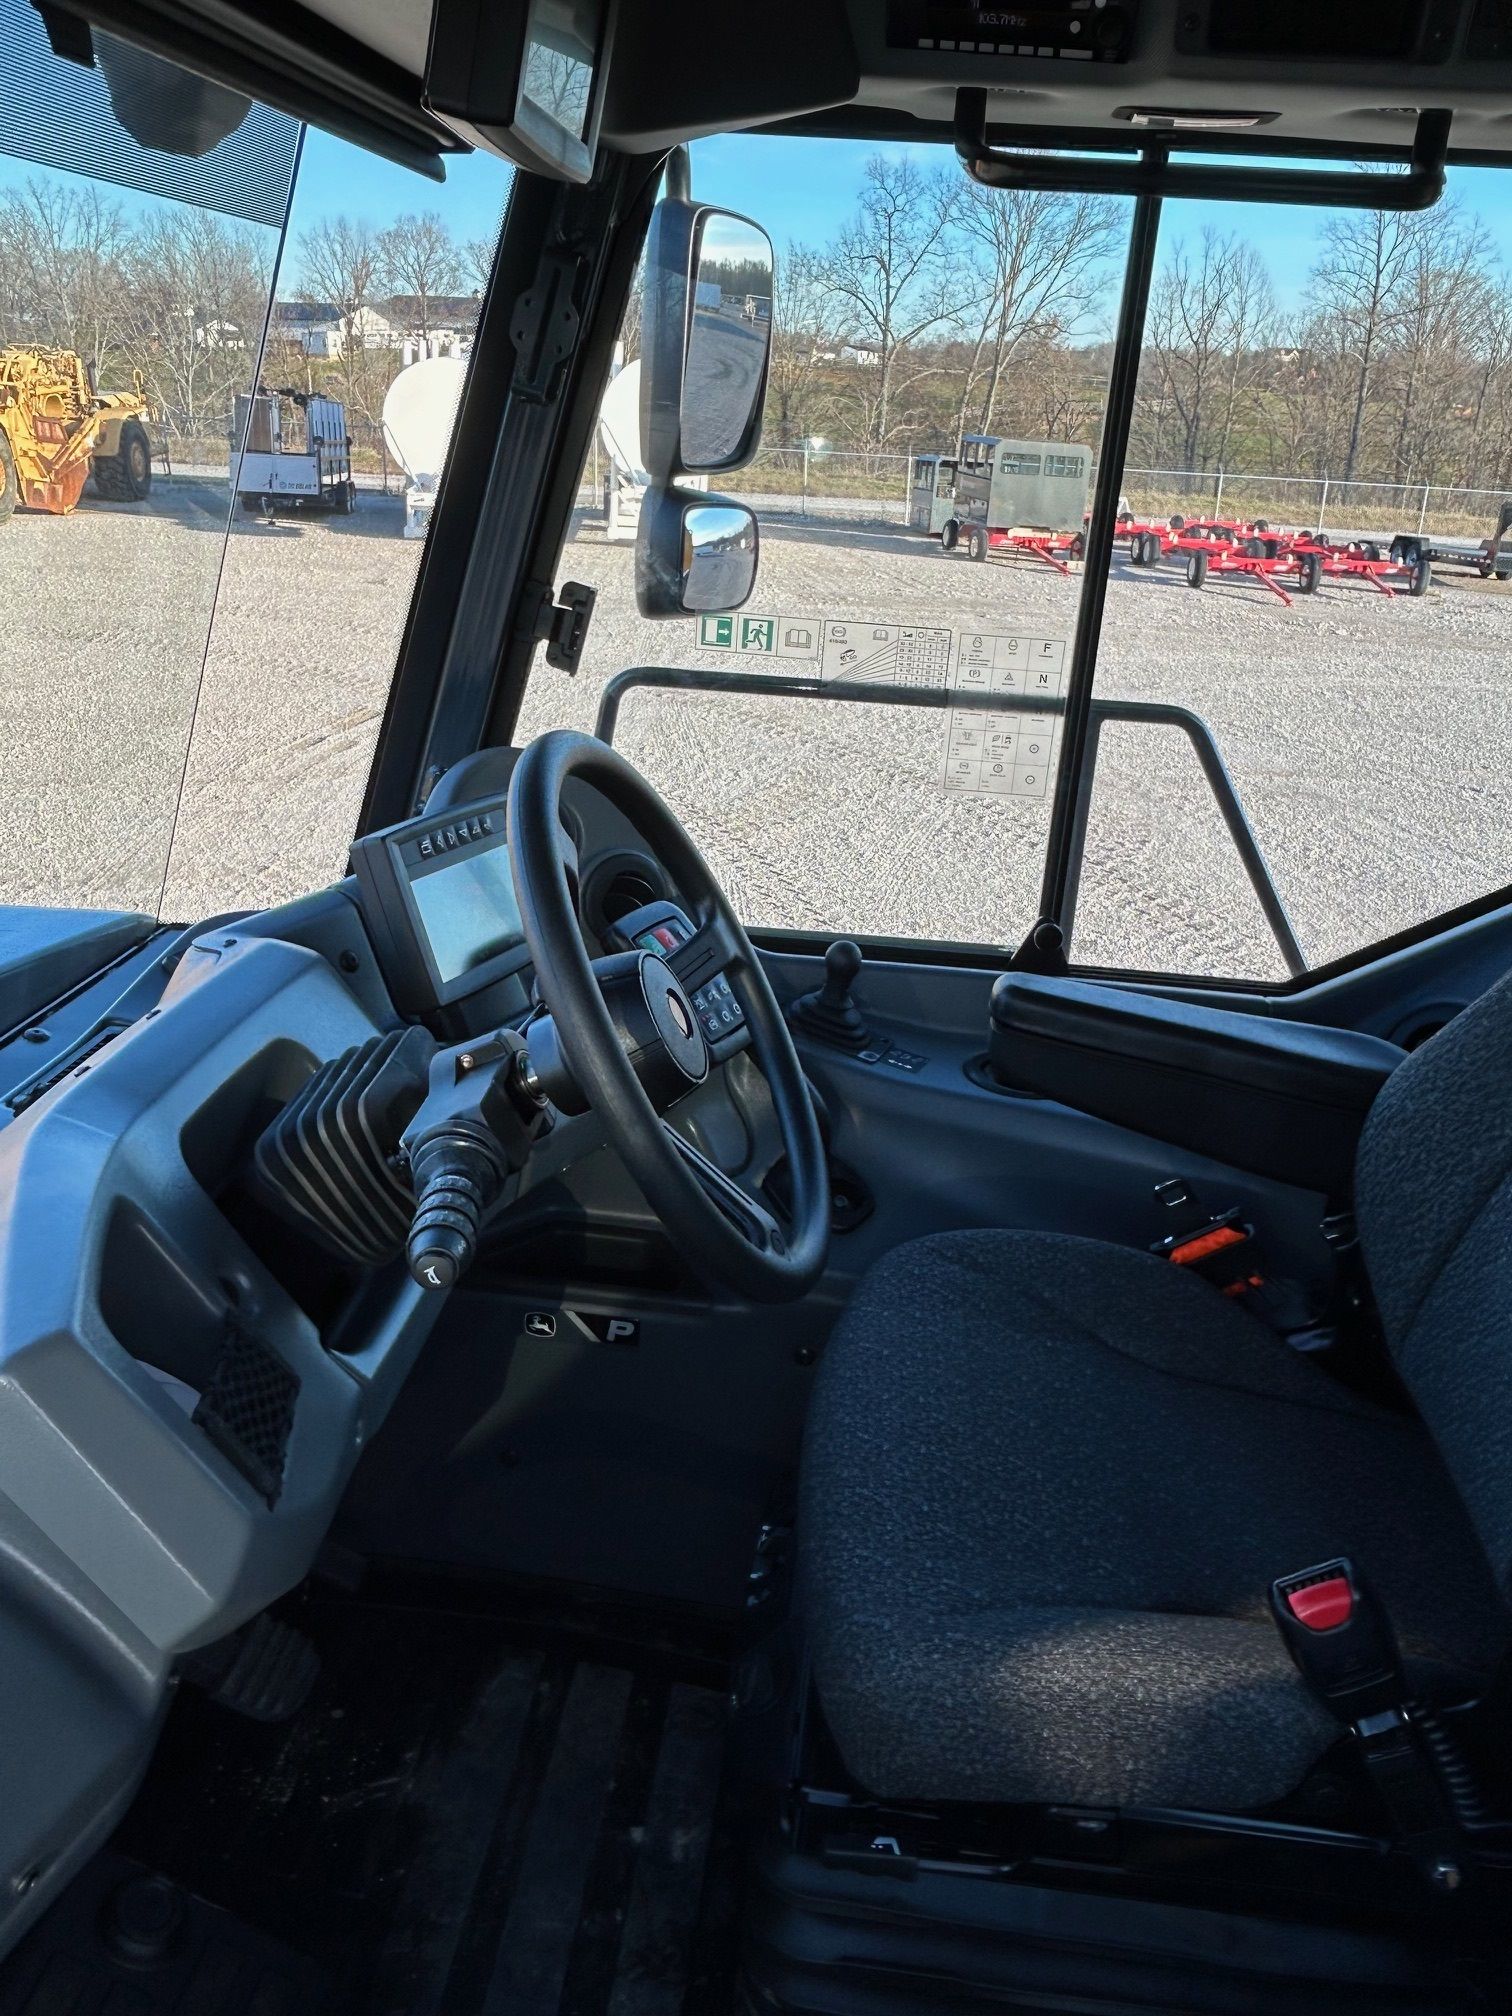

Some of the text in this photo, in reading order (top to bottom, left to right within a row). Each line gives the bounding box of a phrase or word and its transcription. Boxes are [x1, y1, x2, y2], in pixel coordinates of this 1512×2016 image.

[1043, 642, 1052, 653] F
[1039, 674, 1048, 684] N
[606, 1320, 635, 1342] P
